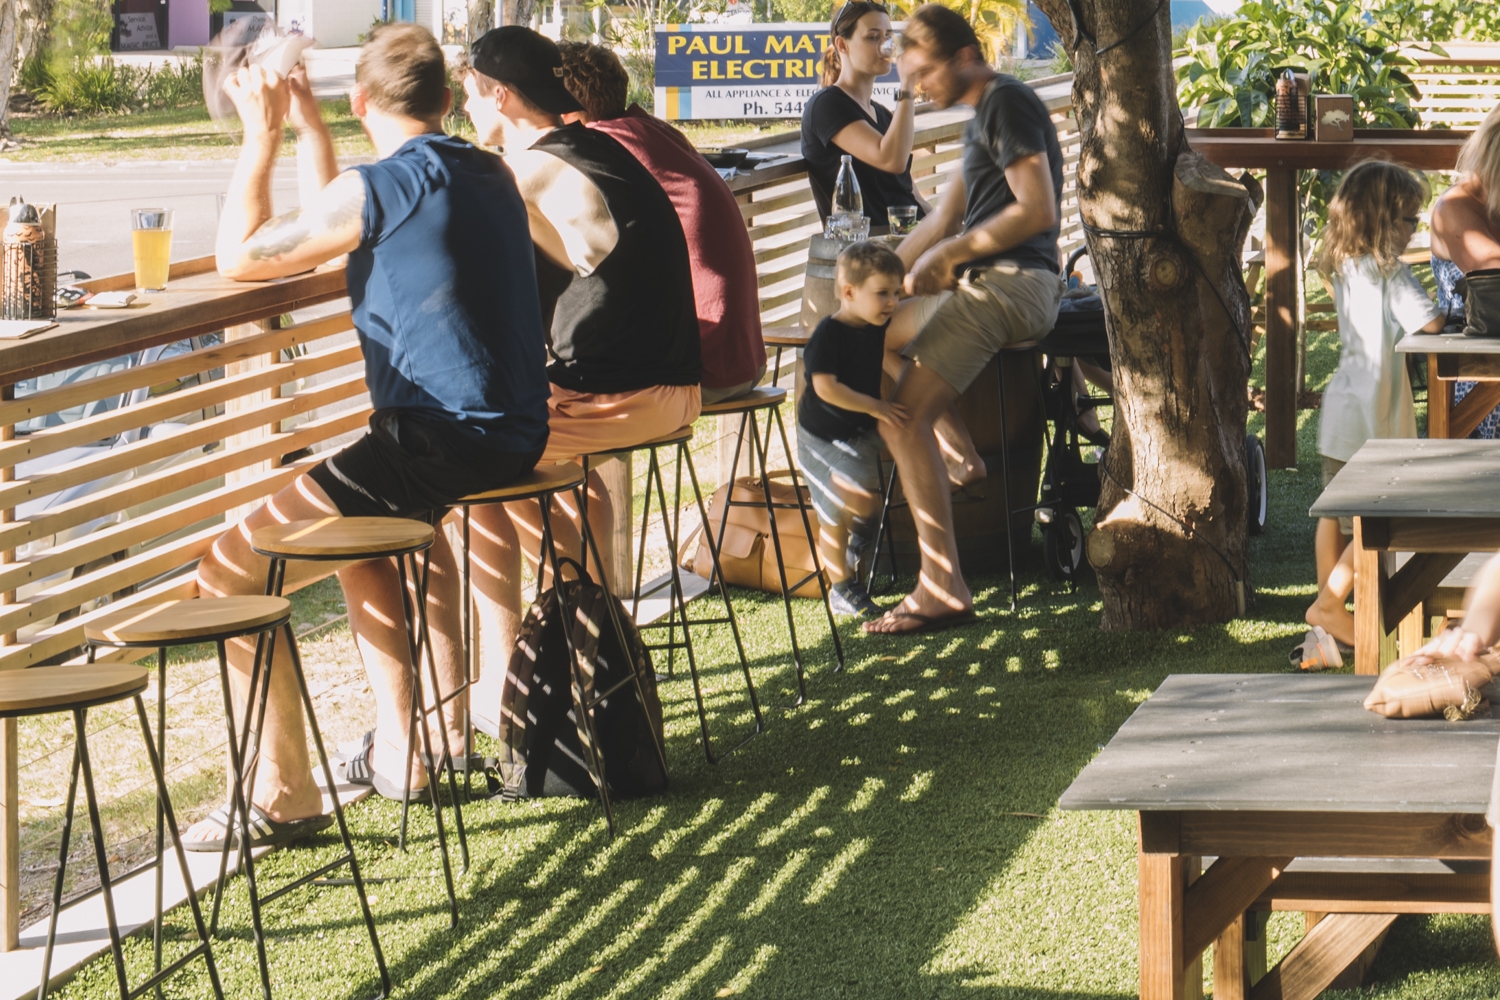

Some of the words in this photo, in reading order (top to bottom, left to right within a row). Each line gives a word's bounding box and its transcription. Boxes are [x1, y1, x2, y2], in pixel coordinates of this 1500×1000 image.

[136, 24, 154, 32] Advice
[120, 41, 140, 50] MAGIC
[141, 40, 160, 49] PRICE
[667, 34, 751, 56] PAUL
[764, 33, 831, 55] MAT
[692, 58, 824, 81] ELECTRI
[705, 89, 723, 99] ALL
[725, 89, 781, 99] APPLIANCE
[784, 89, 792, 98] &
[796, 88, 817, 98] ELEC
[743, 101, 769, 116] Ph.
[774, 101, 807, 115] 544
